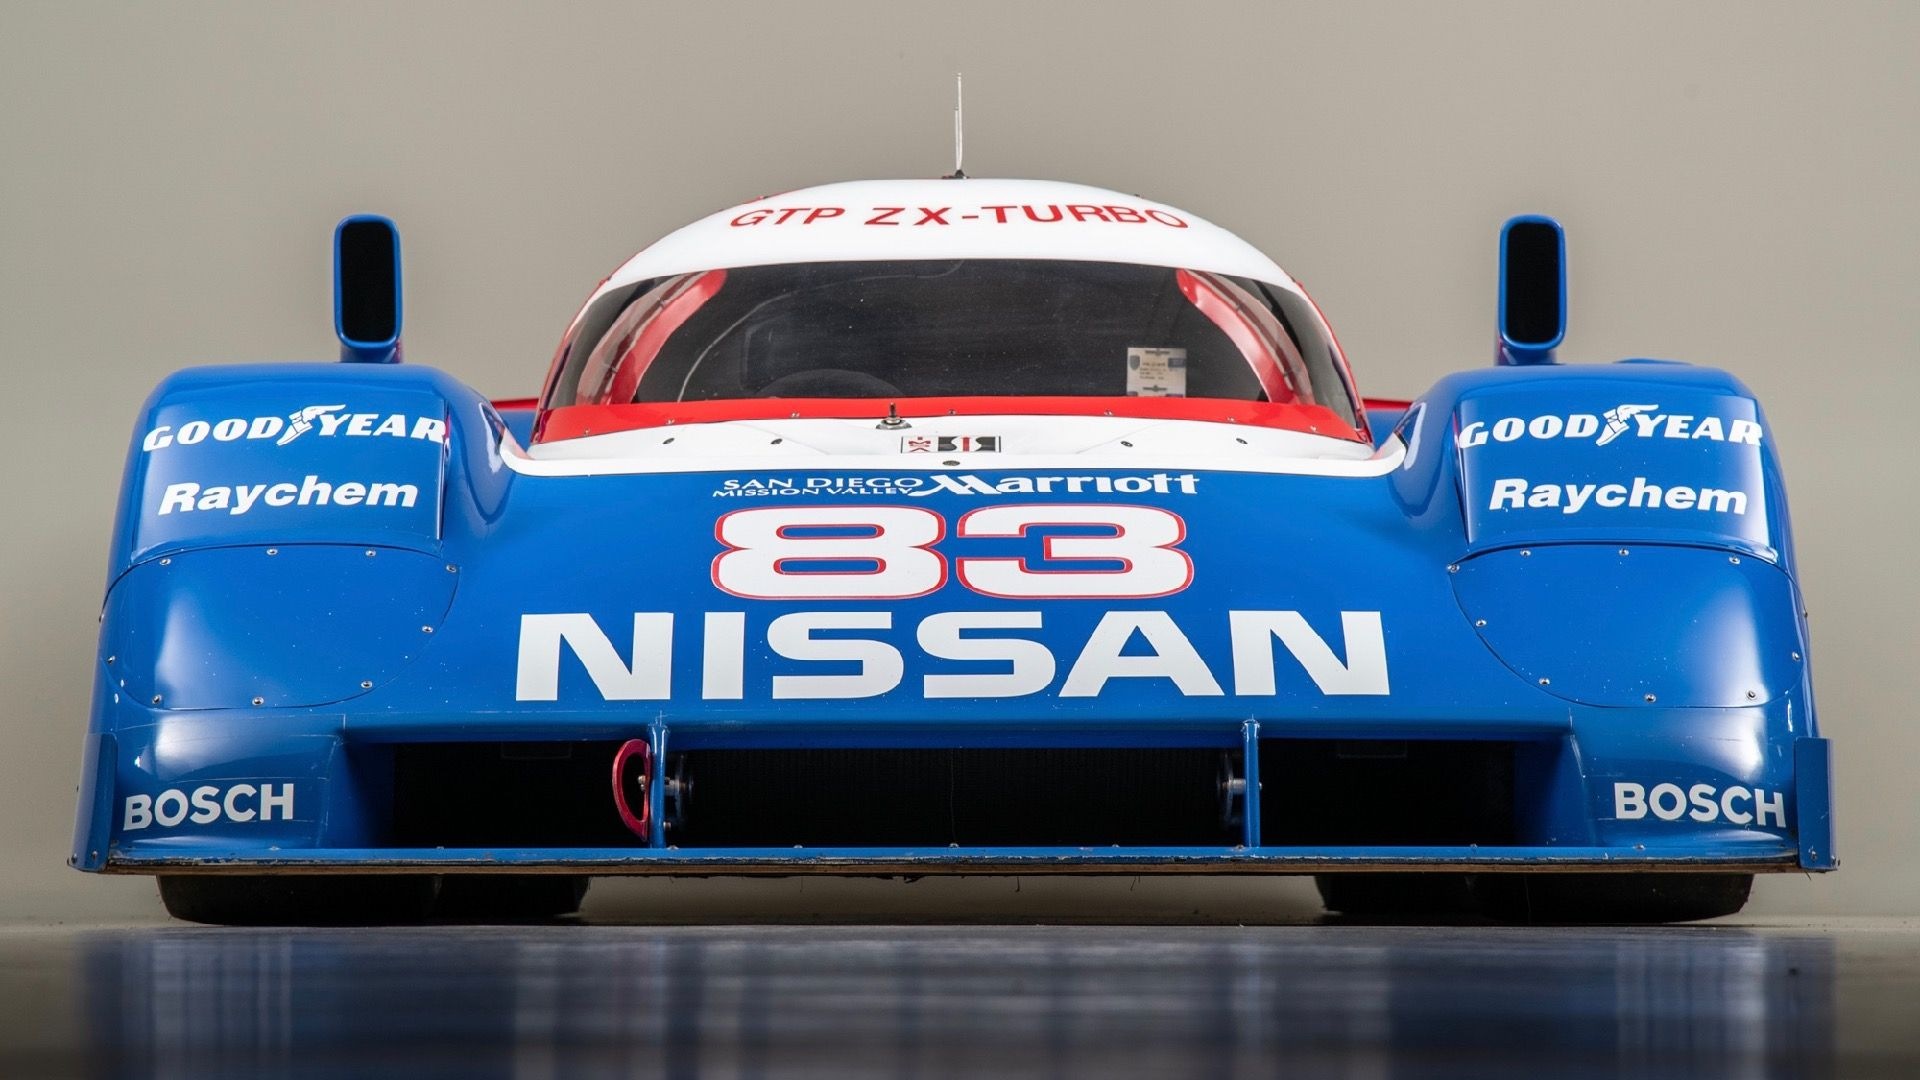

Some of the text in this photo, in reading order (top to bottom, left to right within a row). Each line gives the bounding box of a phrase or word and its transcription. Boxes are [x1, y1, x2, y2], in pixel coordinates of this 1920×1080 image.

[731, 207, 846, 228] GTP
[158, 475, 419, 516] Raychem
[712, 488, 820, 498] MISSION
[723, 477, 924, 490] SAN DIEGO
[907, 474, 1200, 497] Marriott
[1489, 477, 1748, 515] Raychem
[711, 504, 1194, 600] 83
[515, 610, 1391, 702] NISSAN
[122, 783, 295, 831] BOSCH
[1613, 782, 1786, 828] BOSCH
